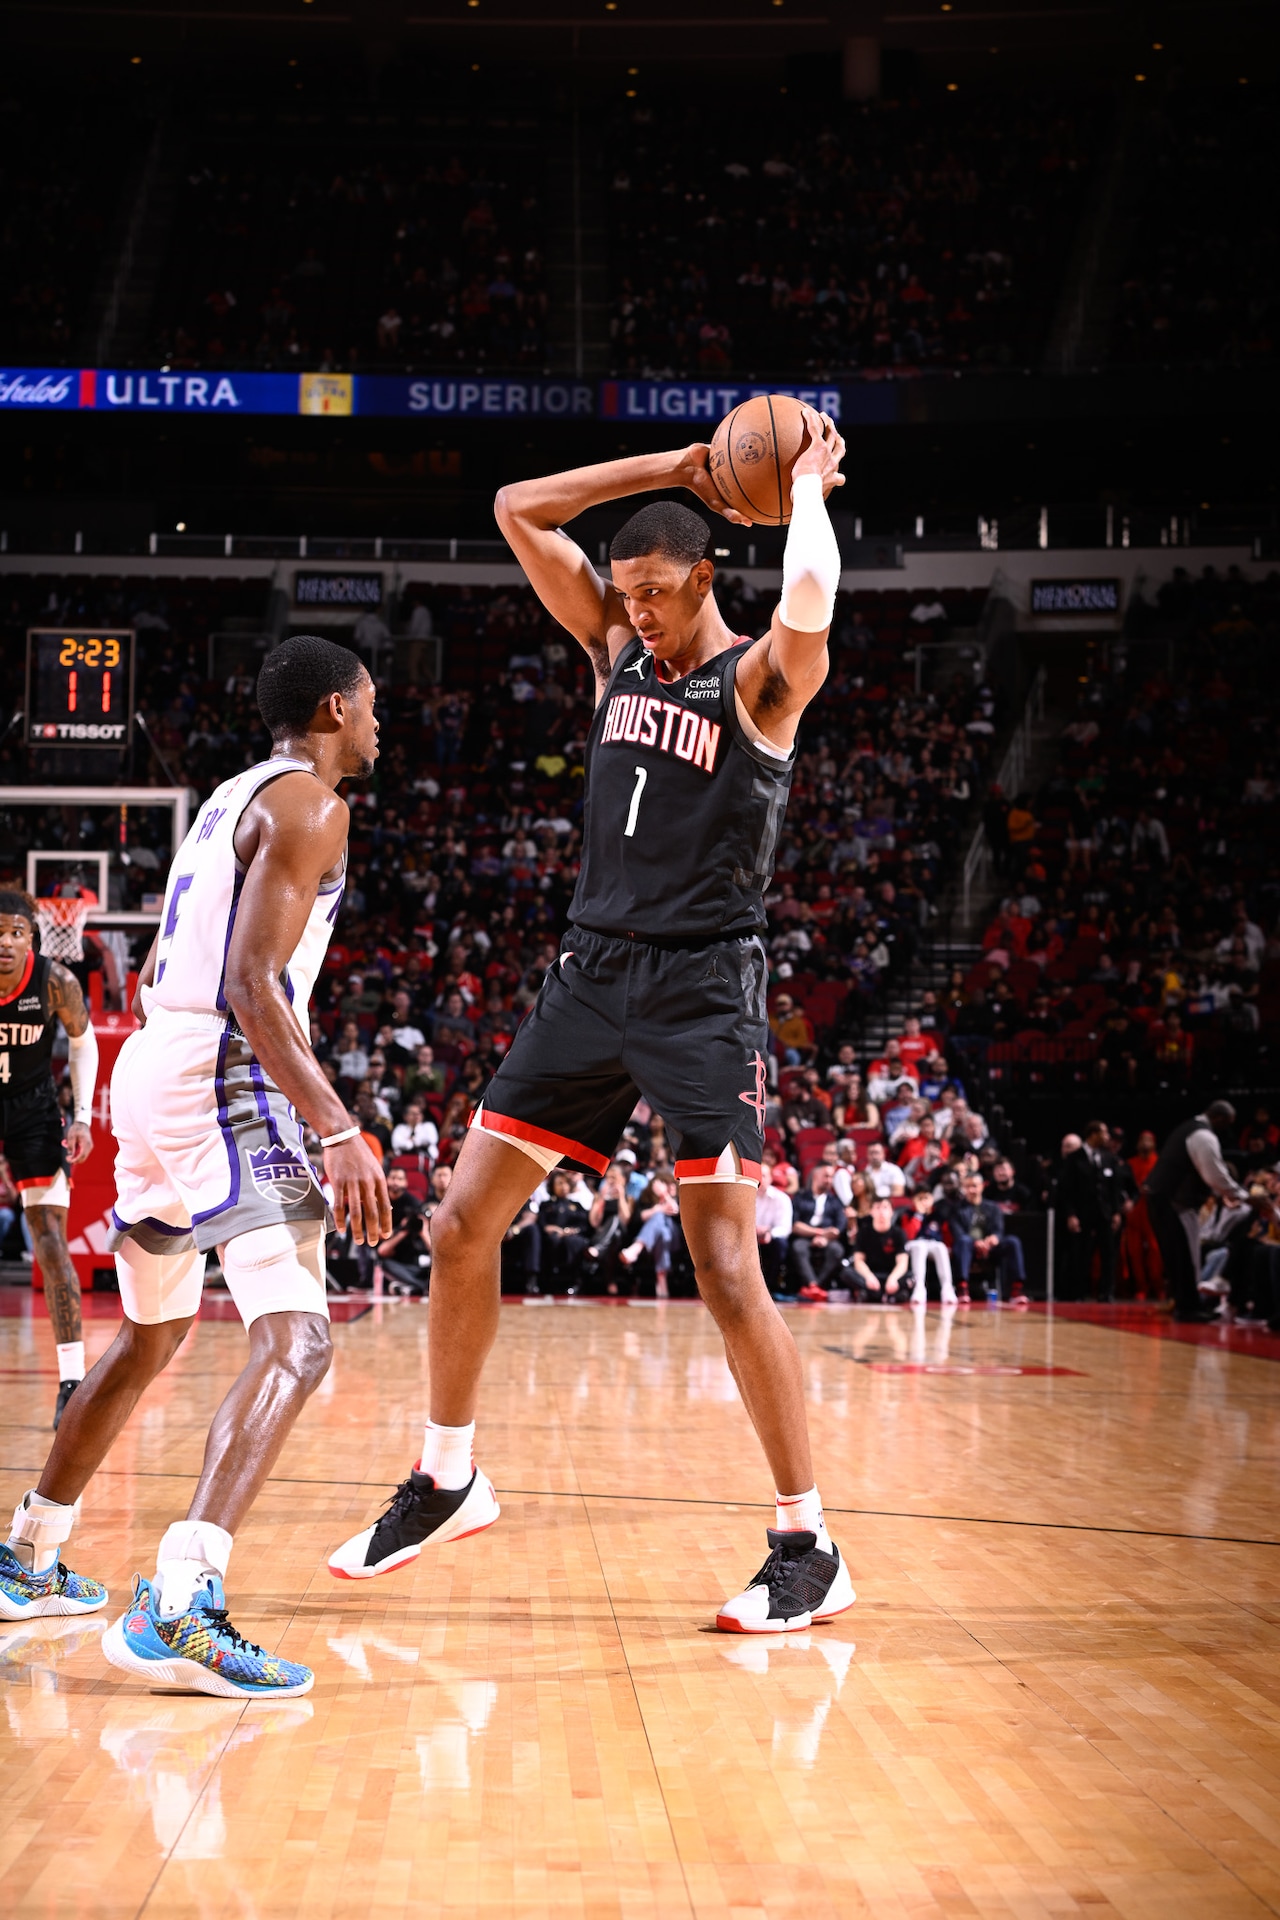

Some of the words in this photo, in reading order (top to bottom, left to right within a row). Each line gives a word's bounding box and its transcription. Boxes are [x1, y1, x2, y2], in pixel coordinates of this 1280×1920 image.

[106, 374, 240, 407] ULTRA
[408, 382, 594, 414] SUPERIOR
[627, 386, 739, 418] LIGHT
[59, 638, 120, 667] 2:23
[684, 688, 720, 699] karma
[689, 677, 720, 688] credit
[58, 724, 125, 739] TISSOT
[600, 694, 721, 774] HOUSTON
[623, 766, 647, 837] 1
[254, 1166, 308, 1183] SAC
